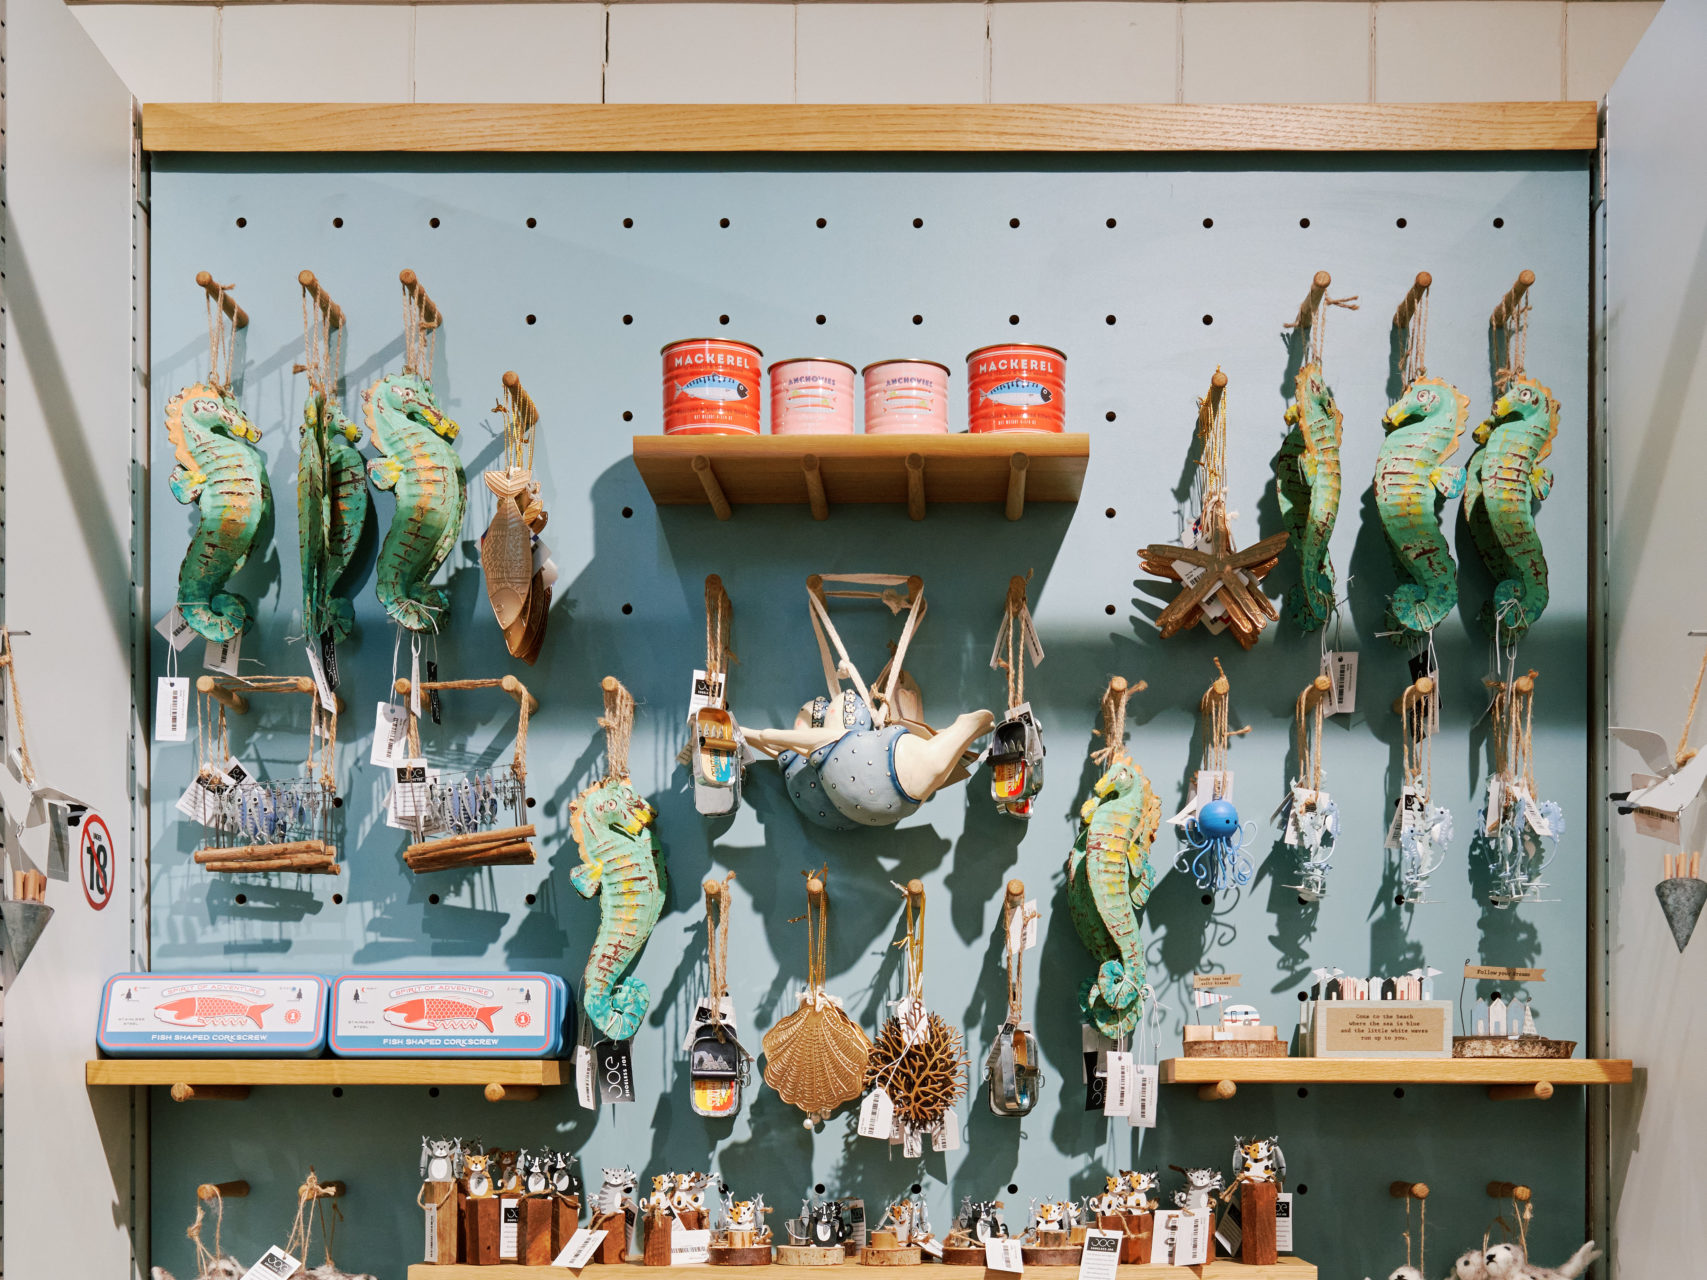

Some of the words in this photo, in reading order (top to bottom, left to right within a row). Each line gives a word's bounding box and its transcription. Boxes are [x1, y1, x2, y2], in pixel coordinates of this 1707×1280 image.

[674, 353, 749, 369] MACKEREL
[980, 359, 1053, 374] MACKEREL
[788, 375, 836, 386] ANCHOVIES
[886, 375, 933, 388] ANCHOVIES
[86, 841, 108, 895] 18
[167, 985, 192, 995] SPIRIT
[211, 984, 262, 995] ADVENTURE
[395, 985, 422, 996] SPIRIT
[438, 984, 489, 996] ADVENTURE
[212, 1034, 268, 1043] CORKSCREW
[443, 1038, 499, 1047] CORKSCREW
[622, 1068, 630, 1097] SHOELESS
